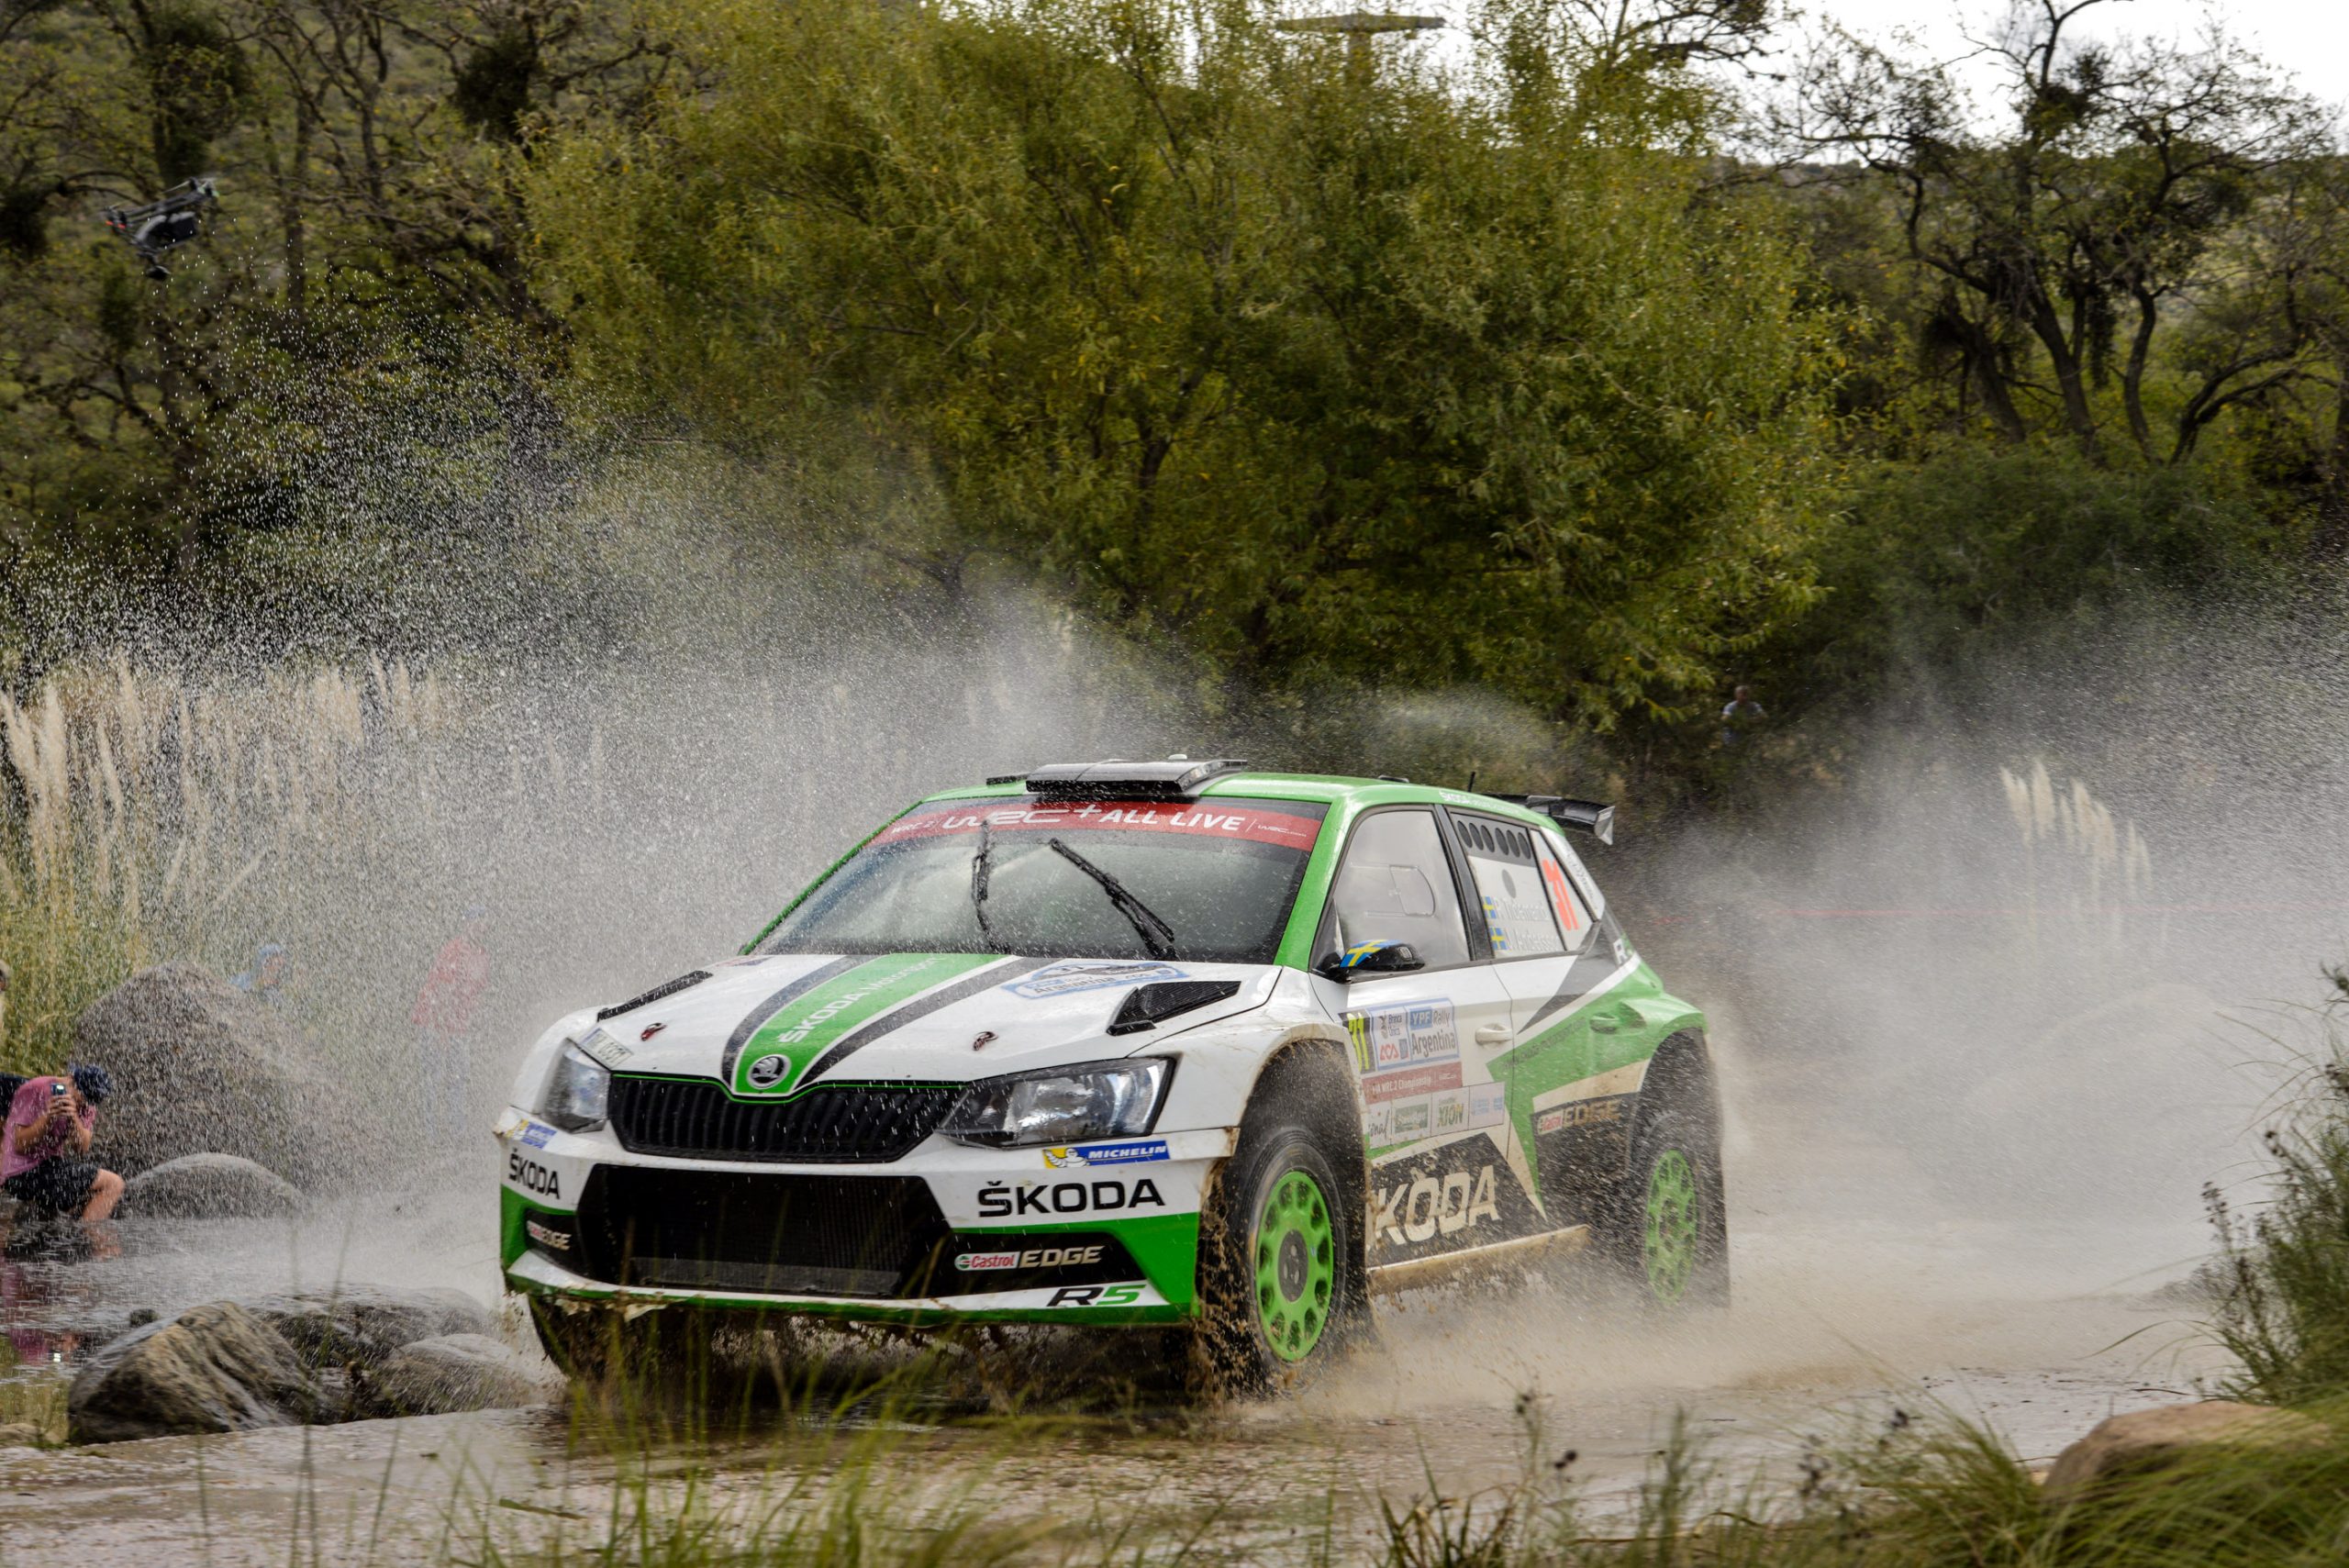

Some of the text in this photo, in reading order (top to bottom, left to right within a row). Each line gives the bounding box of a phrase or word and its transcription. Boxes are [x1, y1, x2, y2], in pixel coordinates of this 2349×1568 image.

[1099, 809, 1159, 824] ALL
[1170, 812, 1245, 831] LIVE
[1412, 1009, 1451, 1026] YPF Rally
[1411, 1029, 1456, 1057] Argentina
[1088, 1145, 1166, 1159] MICHELIN
[509, 1148, 561, 1199] ŠKODA
[978, 1179, 1165, 1218] ŠKODA
[1375, 1164, 1503, 1246] KODA
[969, 1245, 1105, 1268] Castrol EDGE
[1046, 1284, 1147, 1307] R5
